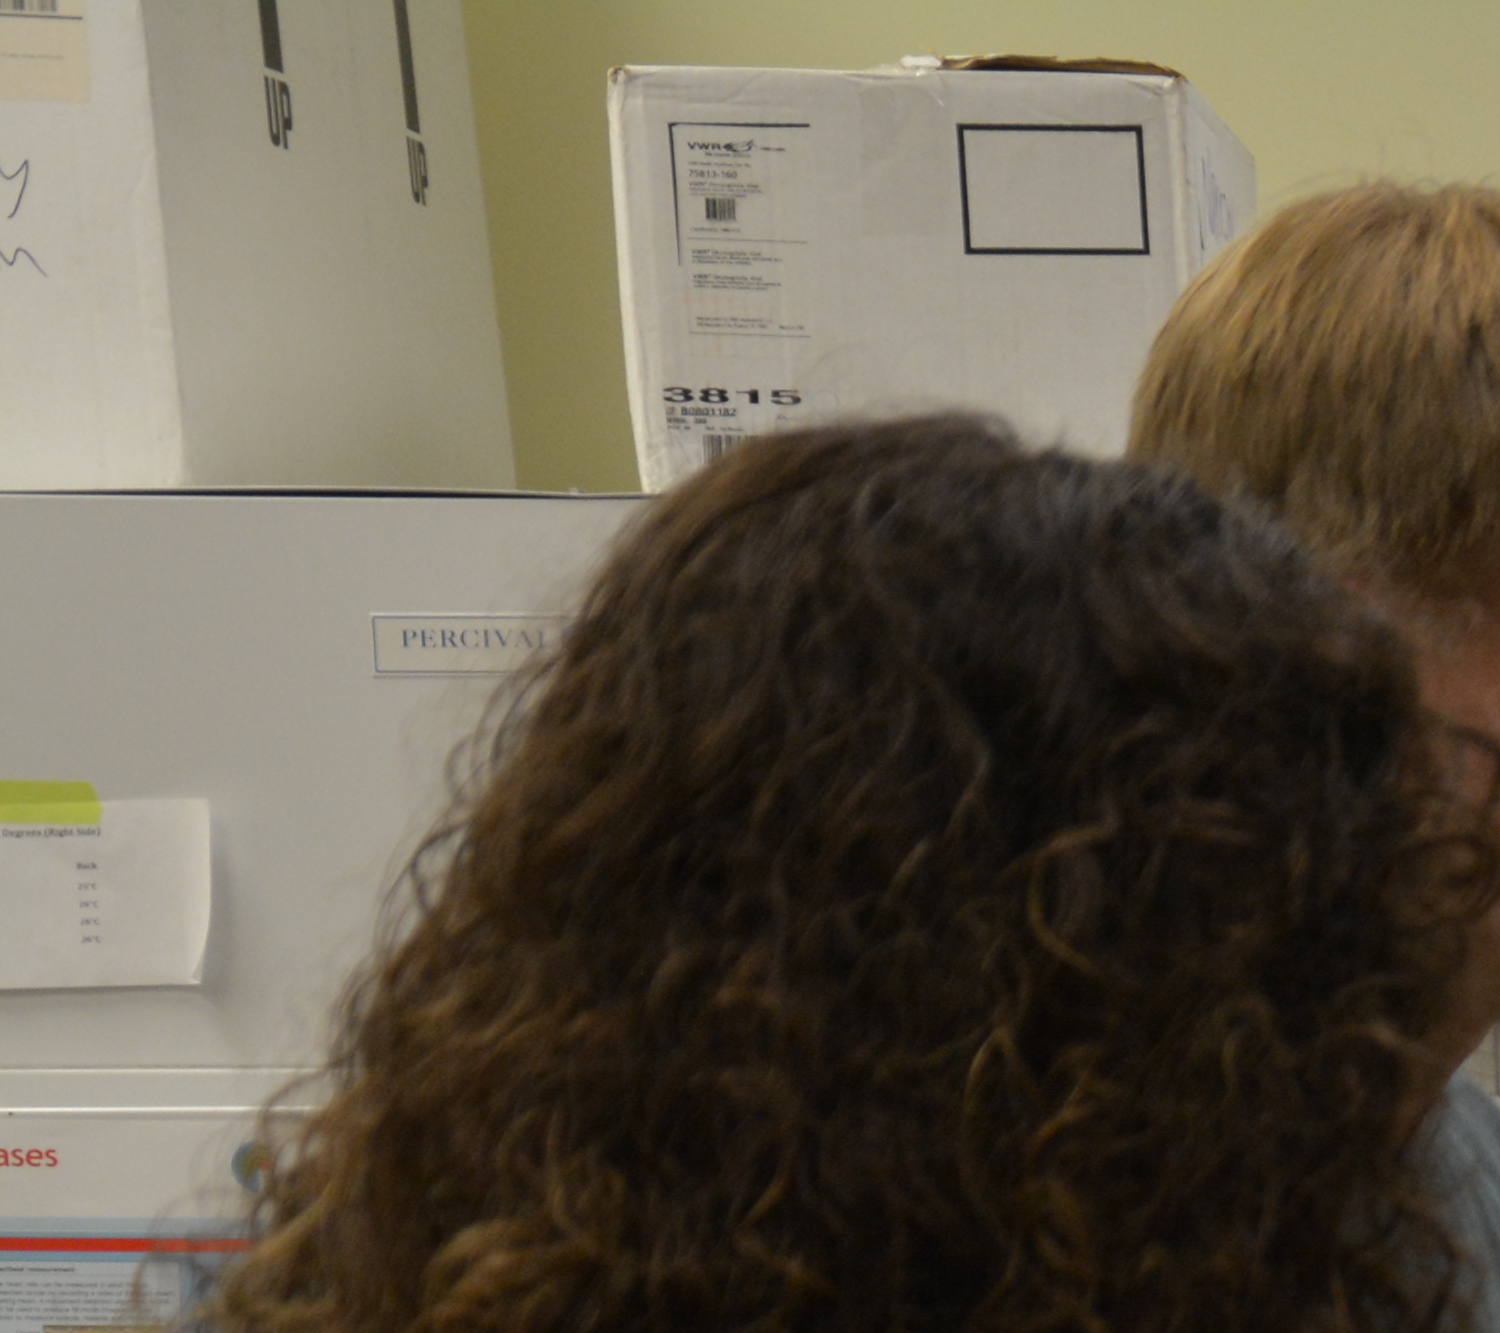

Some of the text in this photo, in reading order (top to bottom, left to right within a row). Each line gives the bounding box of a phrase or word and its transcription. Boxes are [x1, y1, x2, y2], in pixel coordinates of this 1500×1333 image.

[263, 74, 293, 150] UP
[406, 135, 428, 206] UP
[663, 386, 802, 406] 3815
